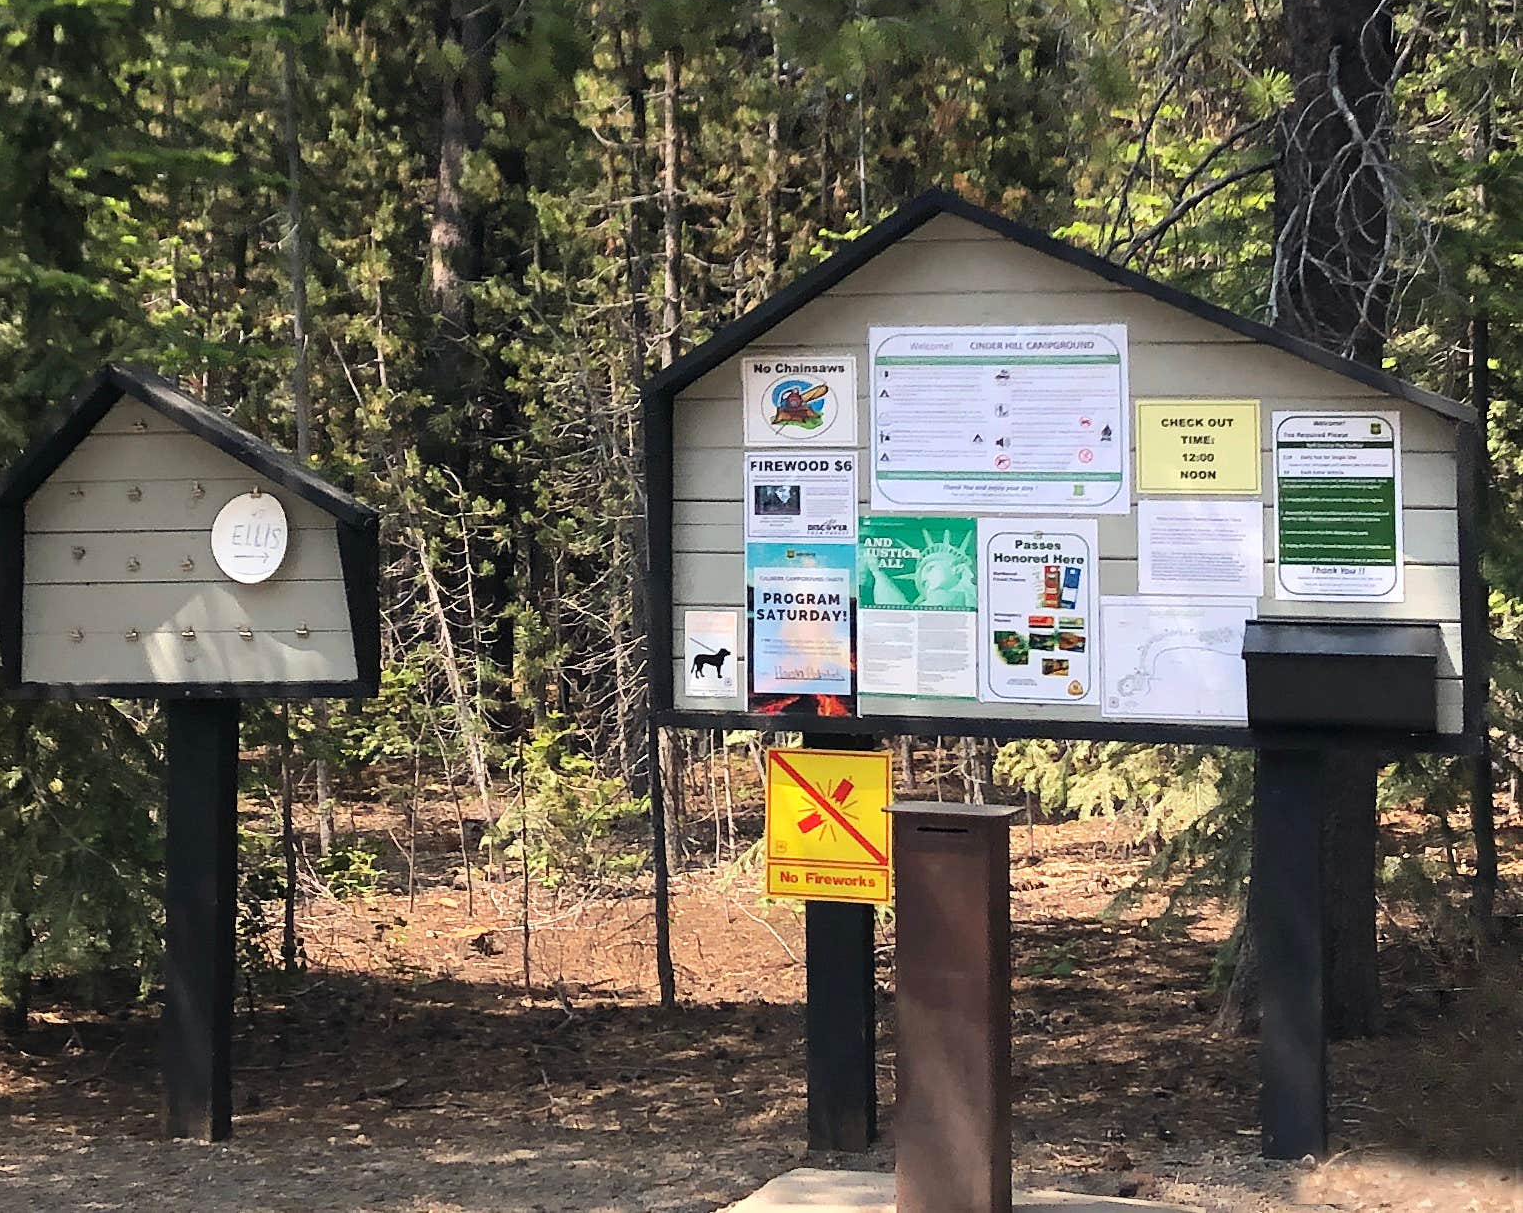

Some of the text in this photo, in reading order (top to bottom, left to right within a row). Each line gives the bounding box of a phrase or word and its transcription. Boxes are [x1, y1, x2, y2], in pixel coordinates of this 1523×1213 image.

[909, 340, 1095, 351] Welcome! CINDER HILL CAMPGROUND
[753, 363, 845, 374] No Chainsaws
[1161, 418, 1234, 428] CHECK OUT
[1180, 435, 1215, 445] TIME:
[1182, 453, 1215, 462] 12:00
[750, 460, 853, 472] FIREWOOD $6
[1180, 470, 1217, 480] NOON
[232, 522, 282, 549] ELLIS
[864, 537, 893, 547] AND
[1015, 539, 1061, 550] Passes
[864, 547, 920, 558] JUSTICE
[878, 558, 905, 568] ALL
[993, 553, 1085, 564] Honored Here
[763, 592, 840, 605] PROGRAM
[756, 609, 847, 622] SATURDAY!
[780, 871, 876, 887] No Fireworks
